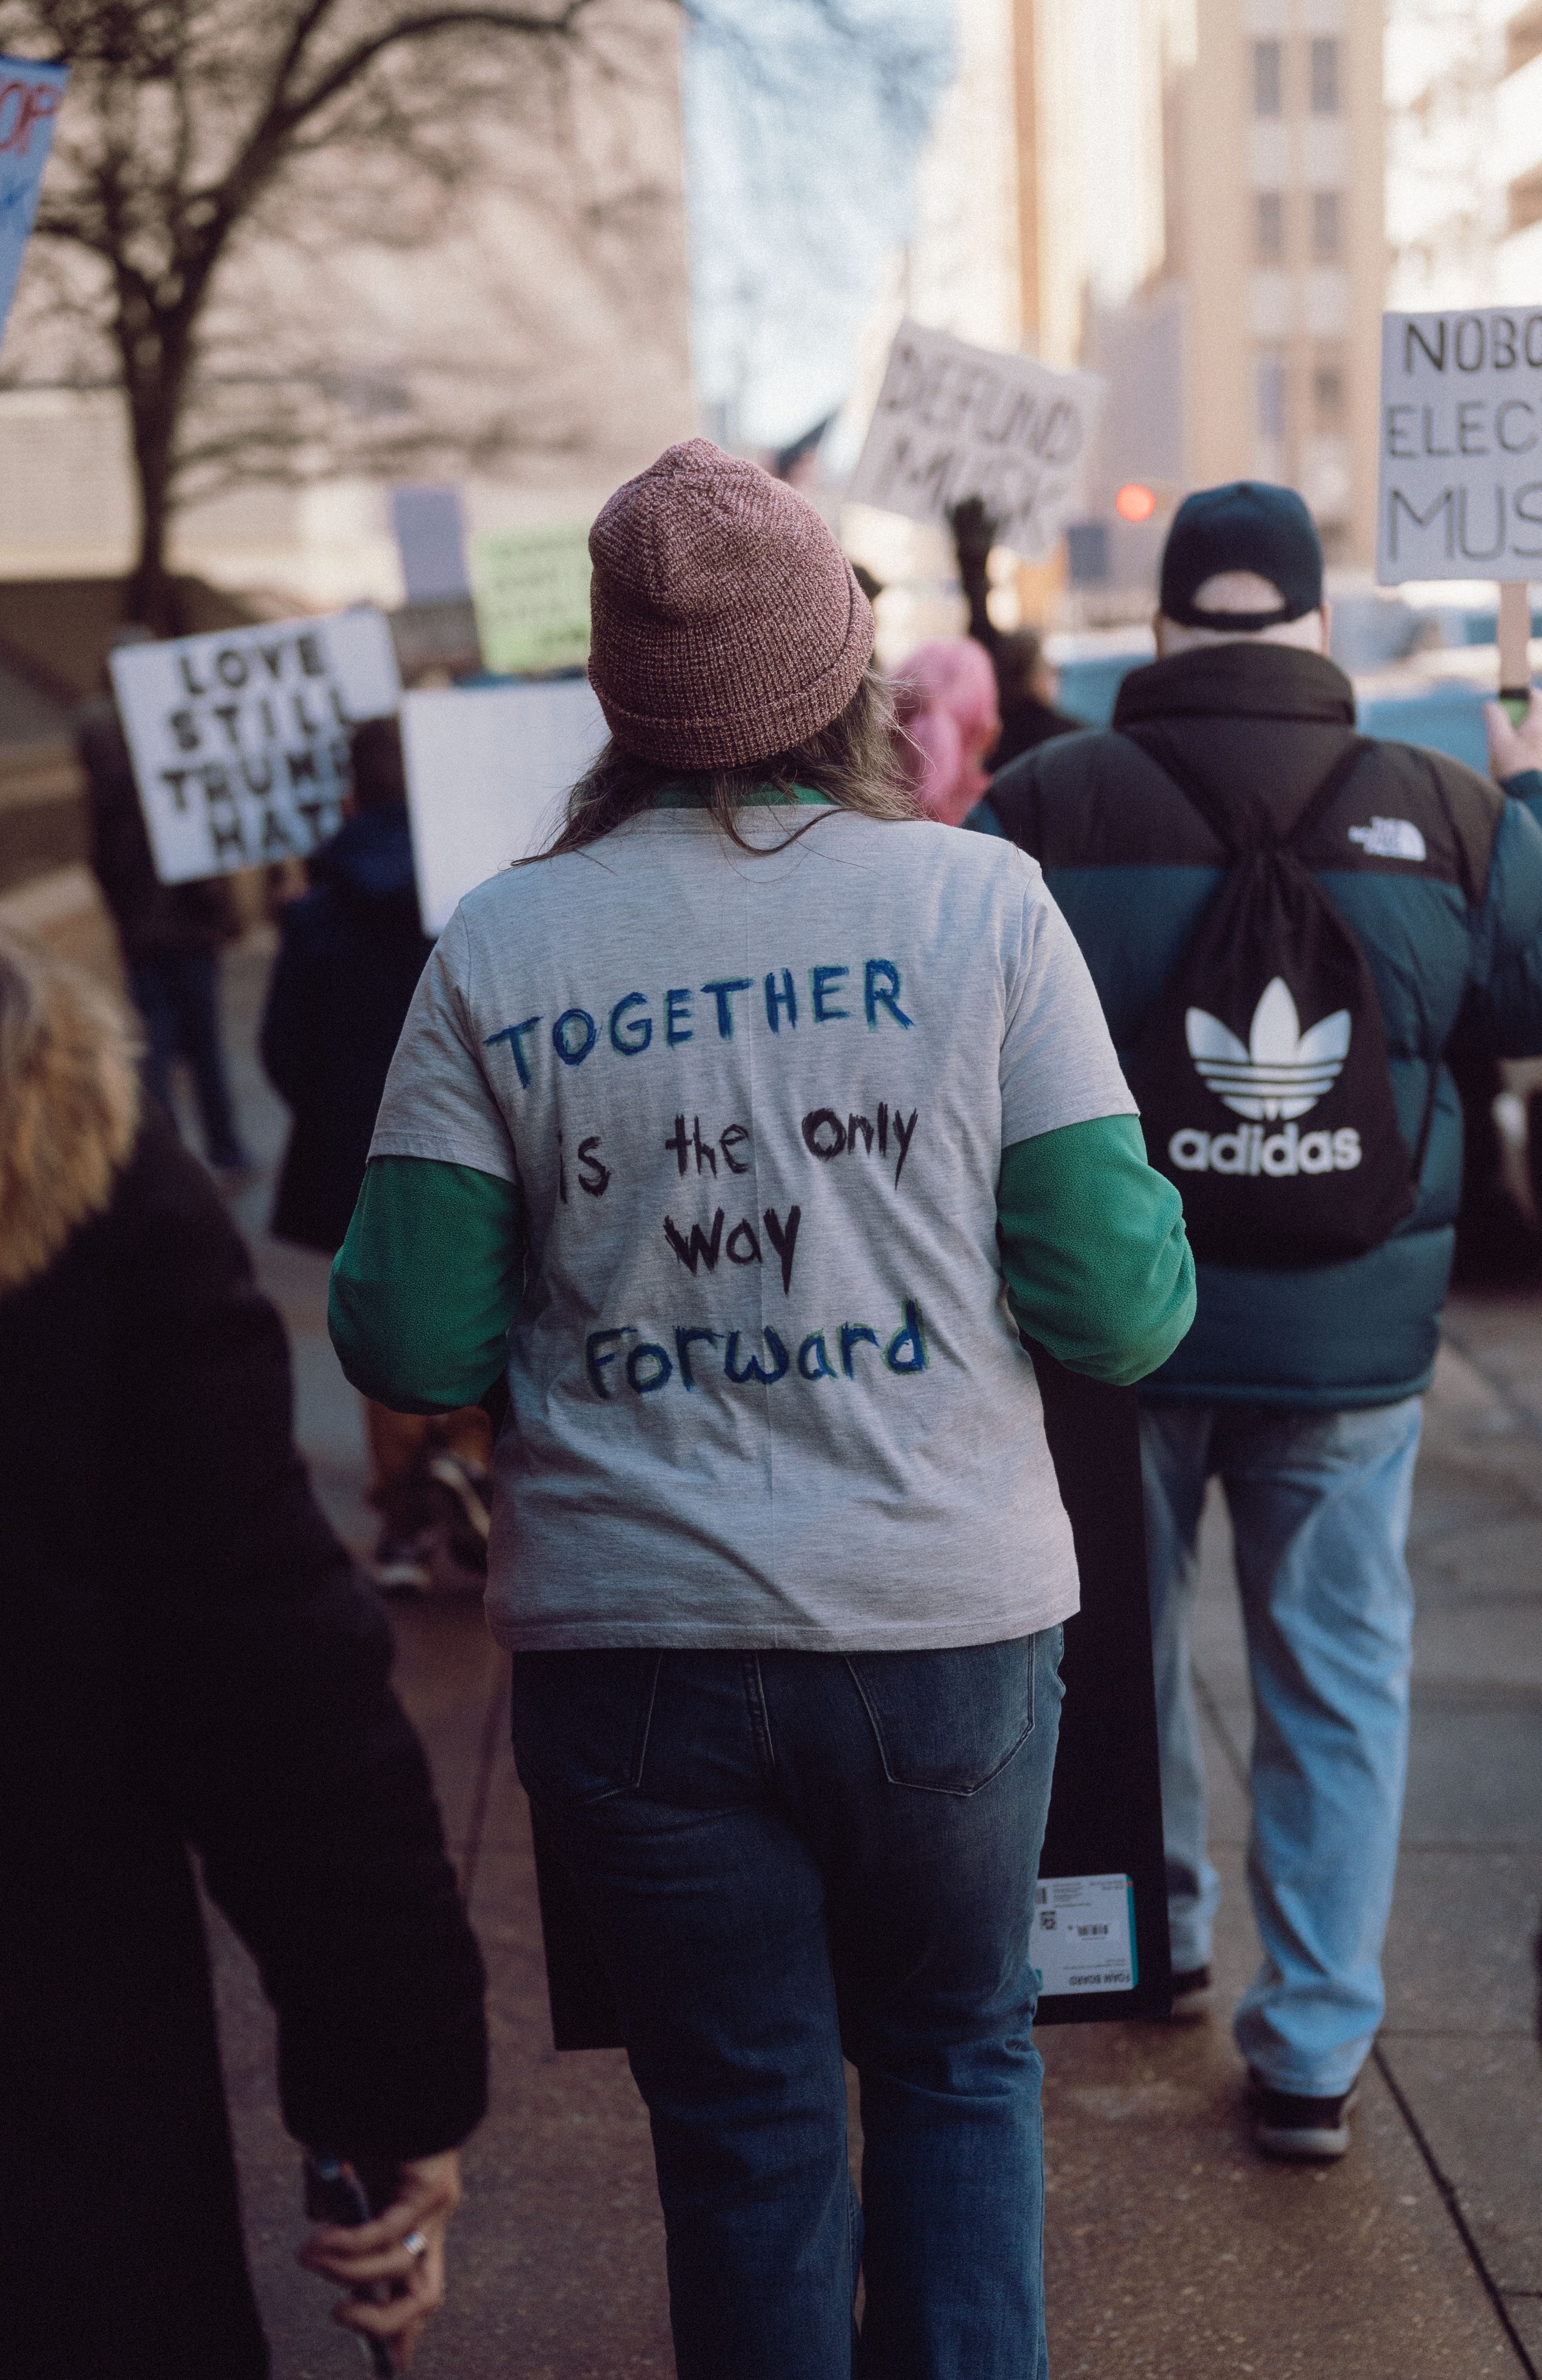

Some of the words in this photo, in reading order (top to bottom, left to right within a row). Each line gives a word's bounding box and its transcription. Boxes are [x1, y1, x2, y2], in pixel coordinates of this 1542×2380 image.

[882, 341, 1085, 466] DEFUND
[178, 636, 325, 695] LOVE
[170, 687, 349, 752] STILL
[483, 957, 915, 1090] TOGETHER
[665, 1113, 749, 1178] the
[1167, 1121, 1362, 1178] adidas
[1069, 1974, 1101, 1987] BOARD
[1103, 1971, 1131, 1984] FOAM
